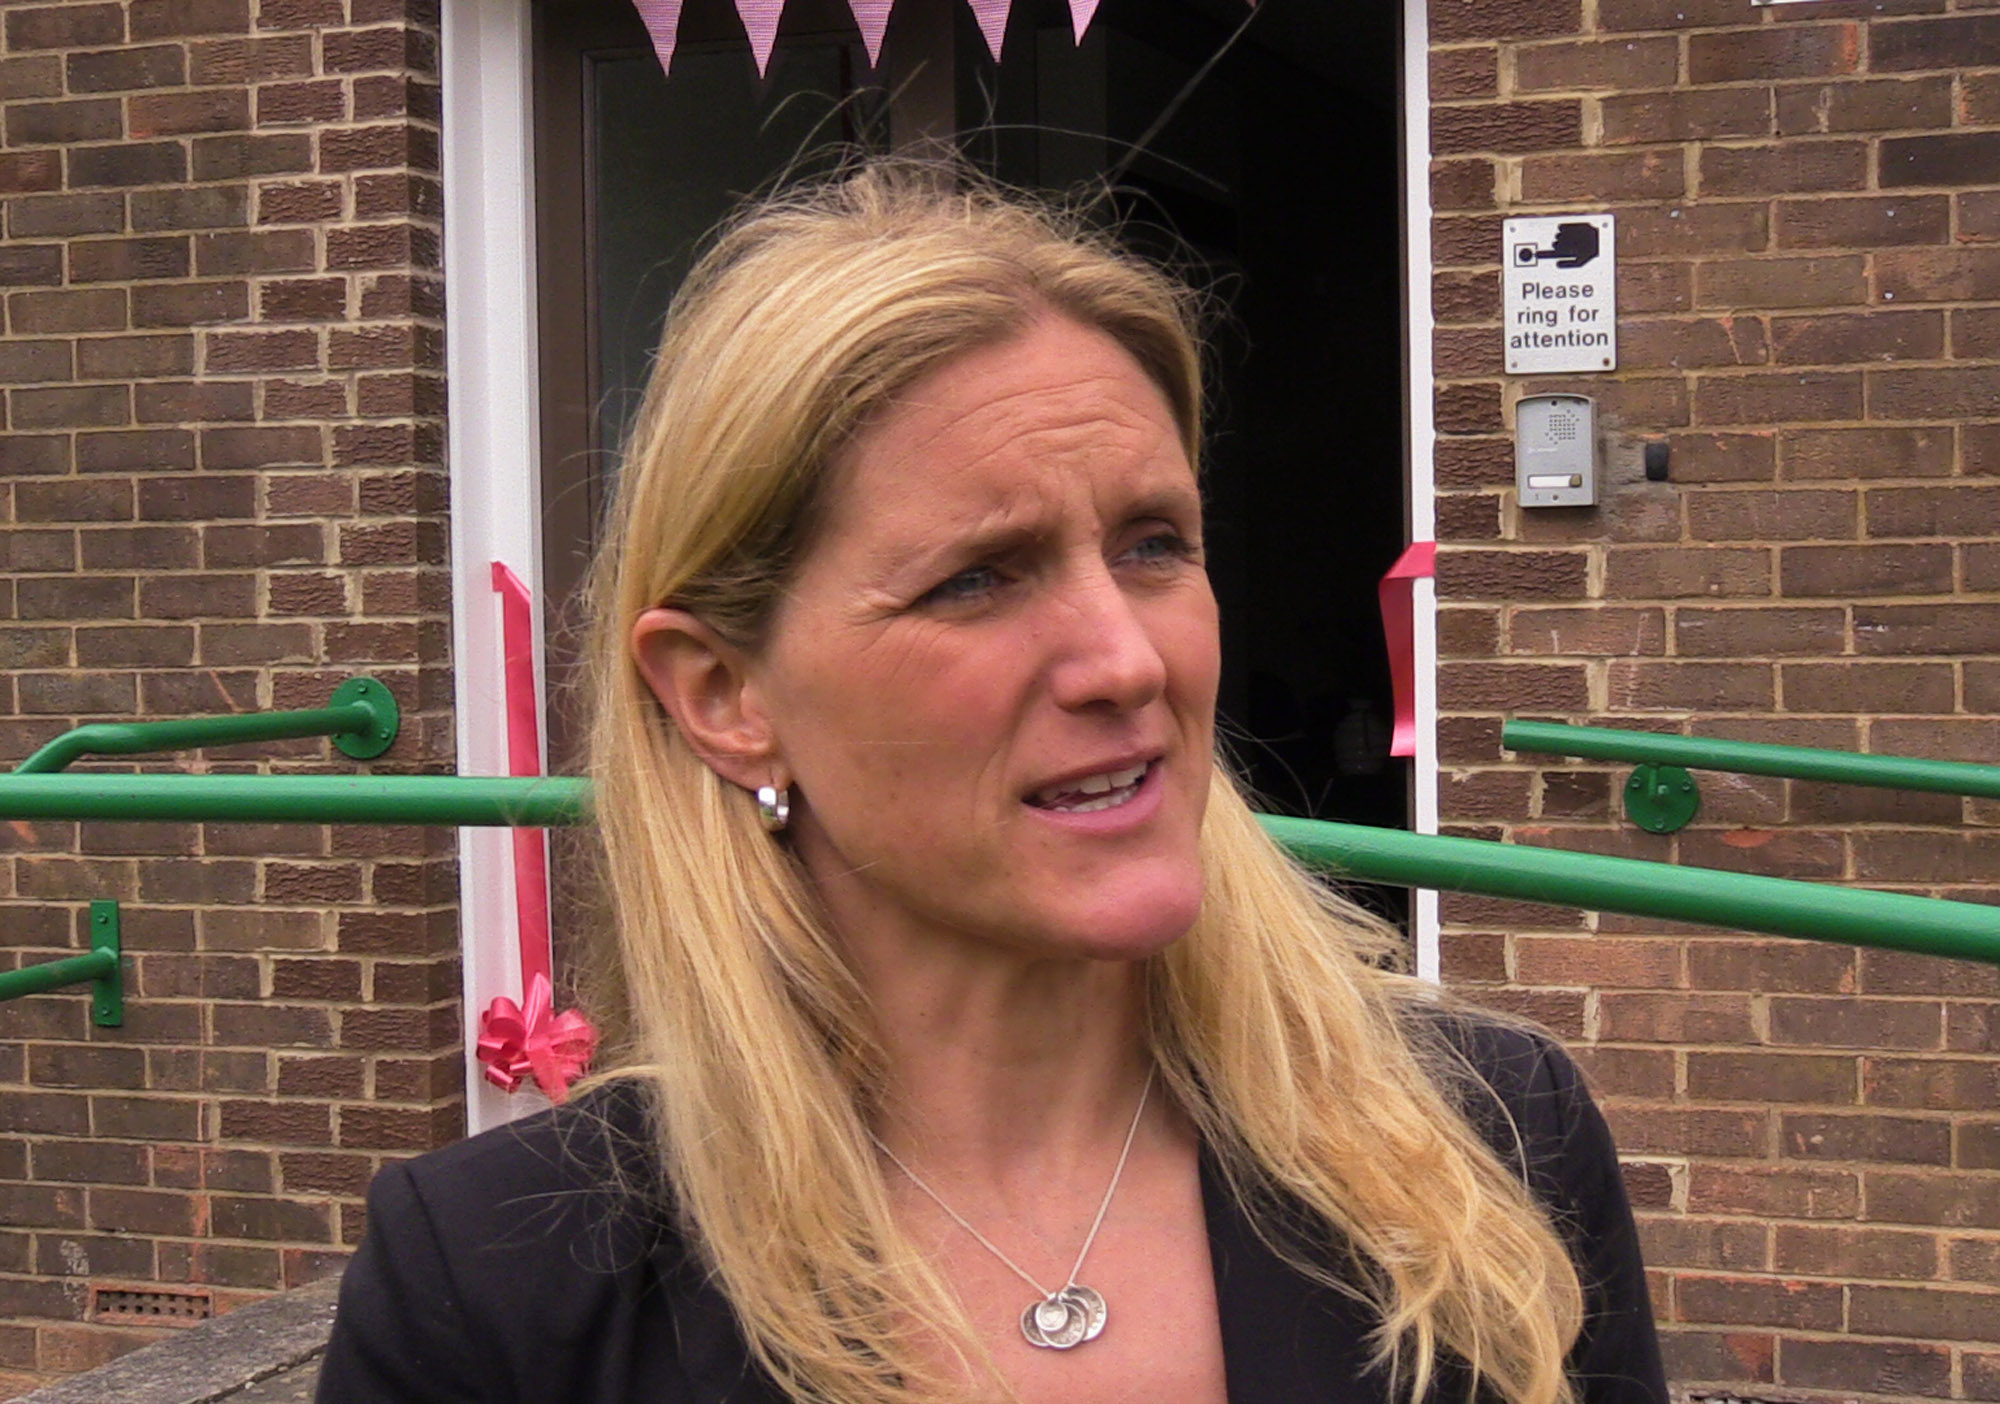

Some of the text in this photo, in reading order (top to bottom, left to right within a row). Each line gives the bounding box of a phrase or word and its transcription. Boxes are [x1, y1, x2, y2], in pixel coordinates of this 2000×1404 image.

[1522, 282, 1594, 300] Please
[1518, 305, 1600, 327] ring for
[1511, 329, 1609, 349] attention
